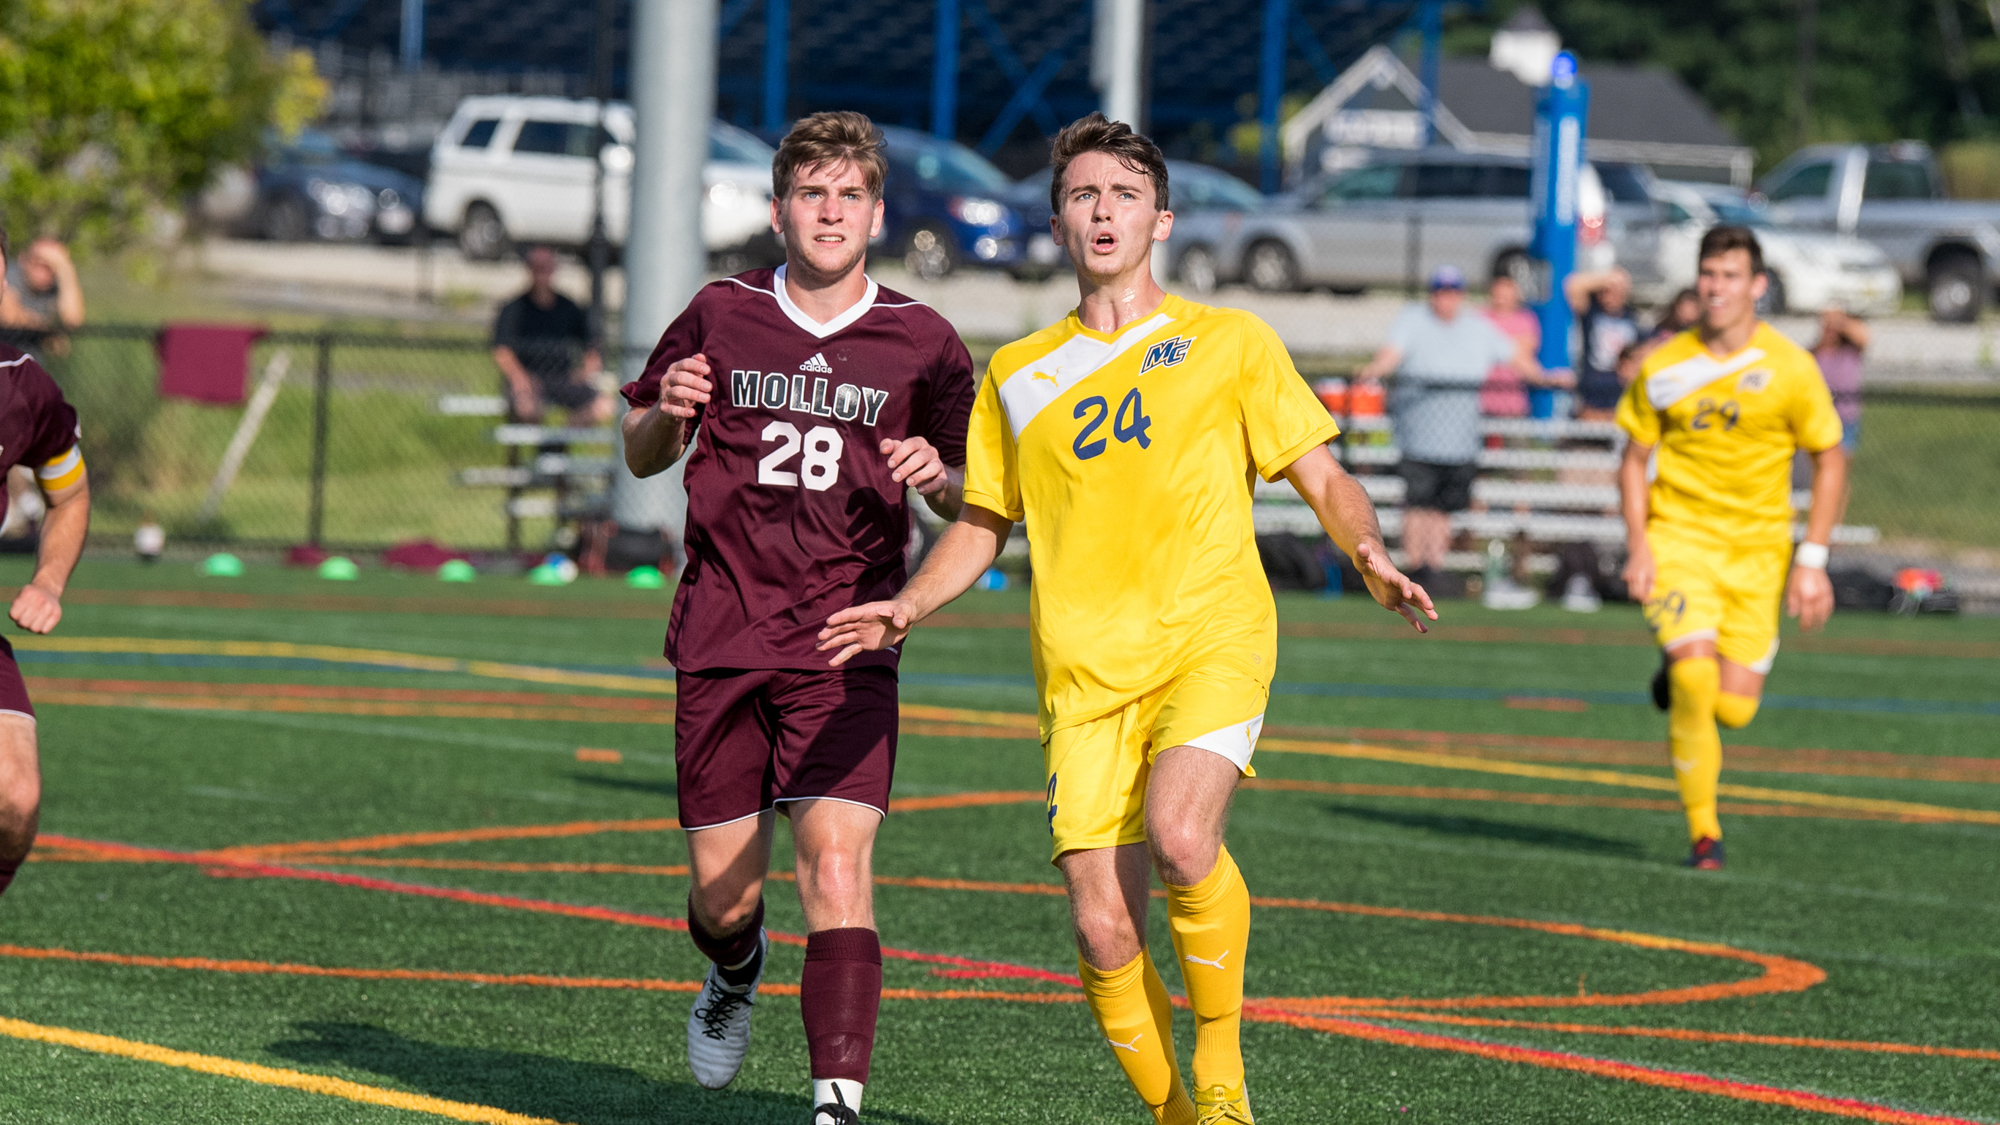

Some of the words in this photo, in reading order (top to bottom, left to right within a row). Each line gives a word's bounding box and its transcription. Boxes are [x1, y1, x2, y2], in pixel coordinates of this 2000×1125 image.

[799, 364, 833, 374] adidas
[1138, 334, 1197, 376] MC
[731, 370, 889, 427] MOLLOY
[1690, 397, 1741, 432] 29
[1072, 387, 1152, 461] 24
[758, 420, 844, 491] 28
